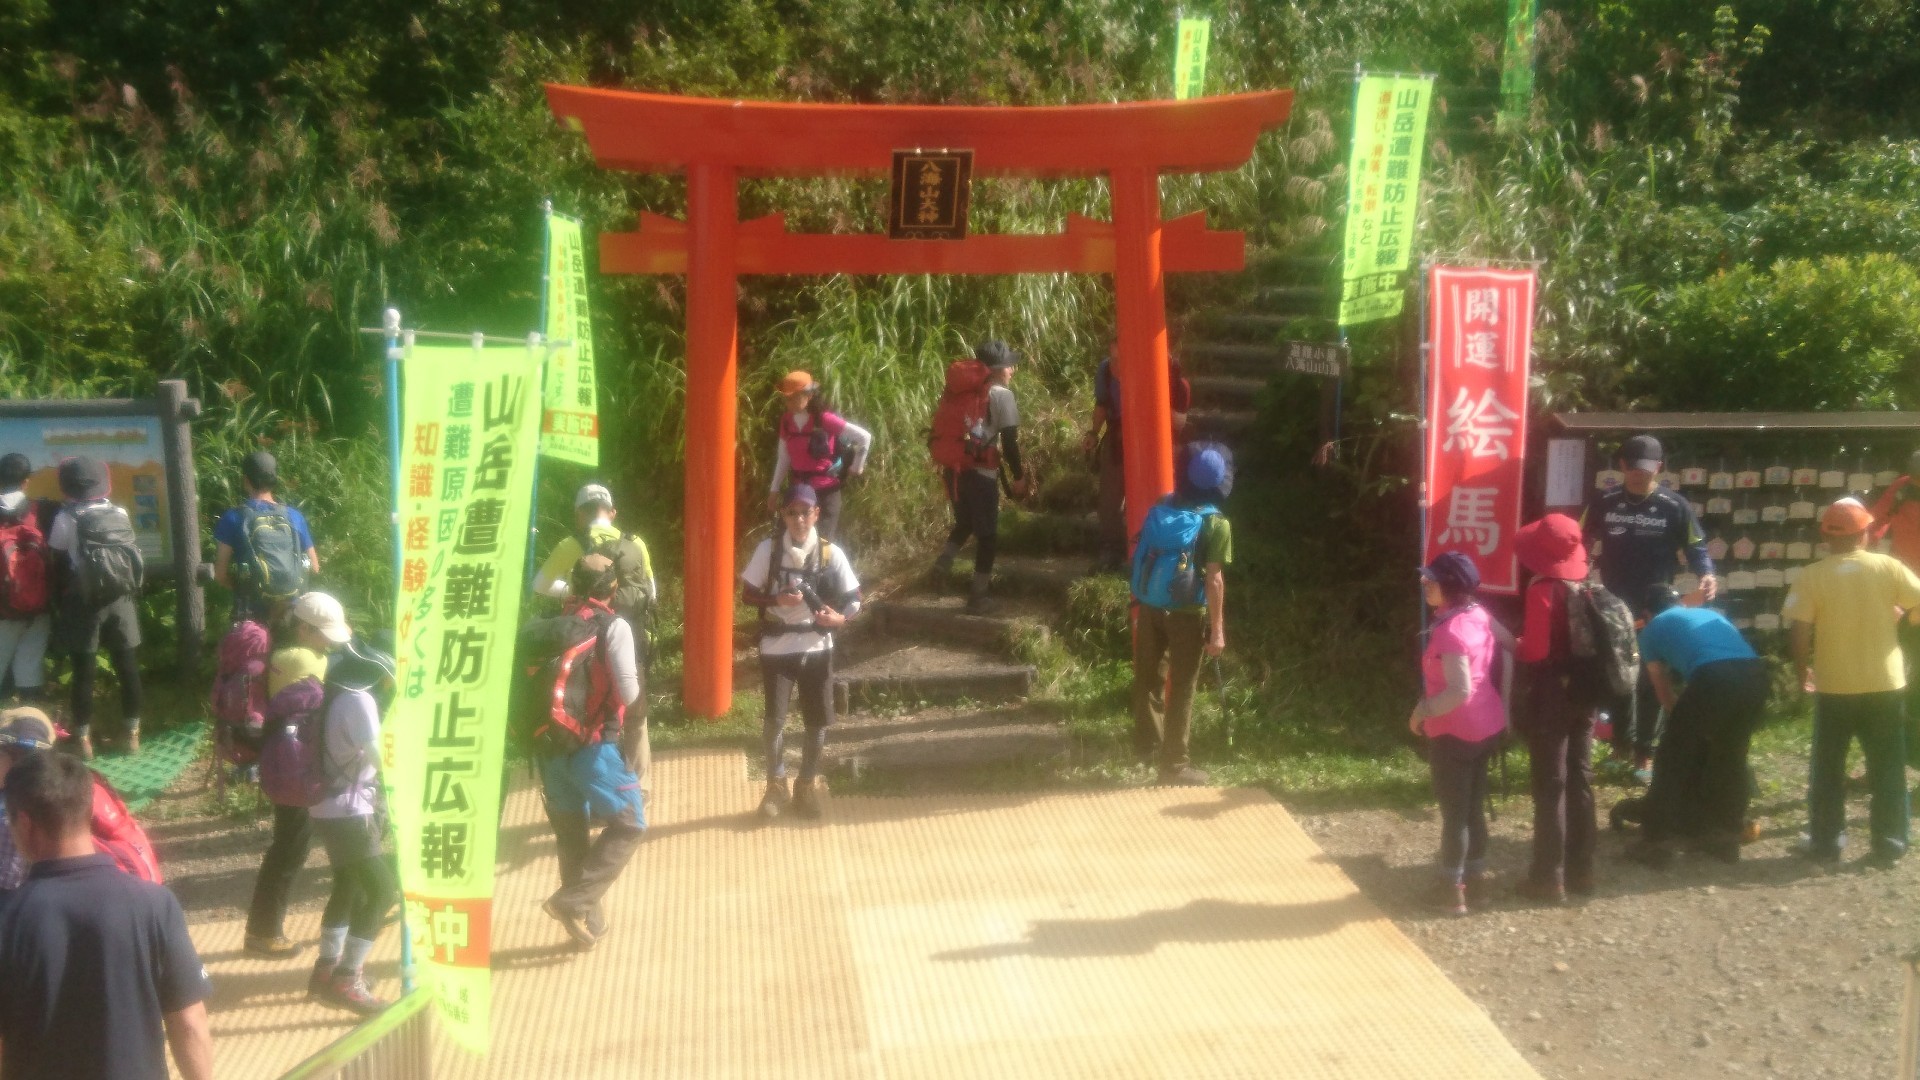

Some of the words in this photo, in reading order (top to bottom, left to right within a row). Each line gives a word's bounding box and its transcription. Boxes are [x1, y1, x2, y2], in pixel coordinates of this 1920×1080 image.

[1376, 89, 1420, 266] 山岳遭難防止広報
[1464, 287, 1500, 369] 開運
[403, 381, 475, 699] 遭難原因の多くは
[1438, 386, 1520, 556] 絵馬
[1605, 512, 1668, 528] MoveSport
[420, 374, 523, 881] 山岳遭難防止広報
